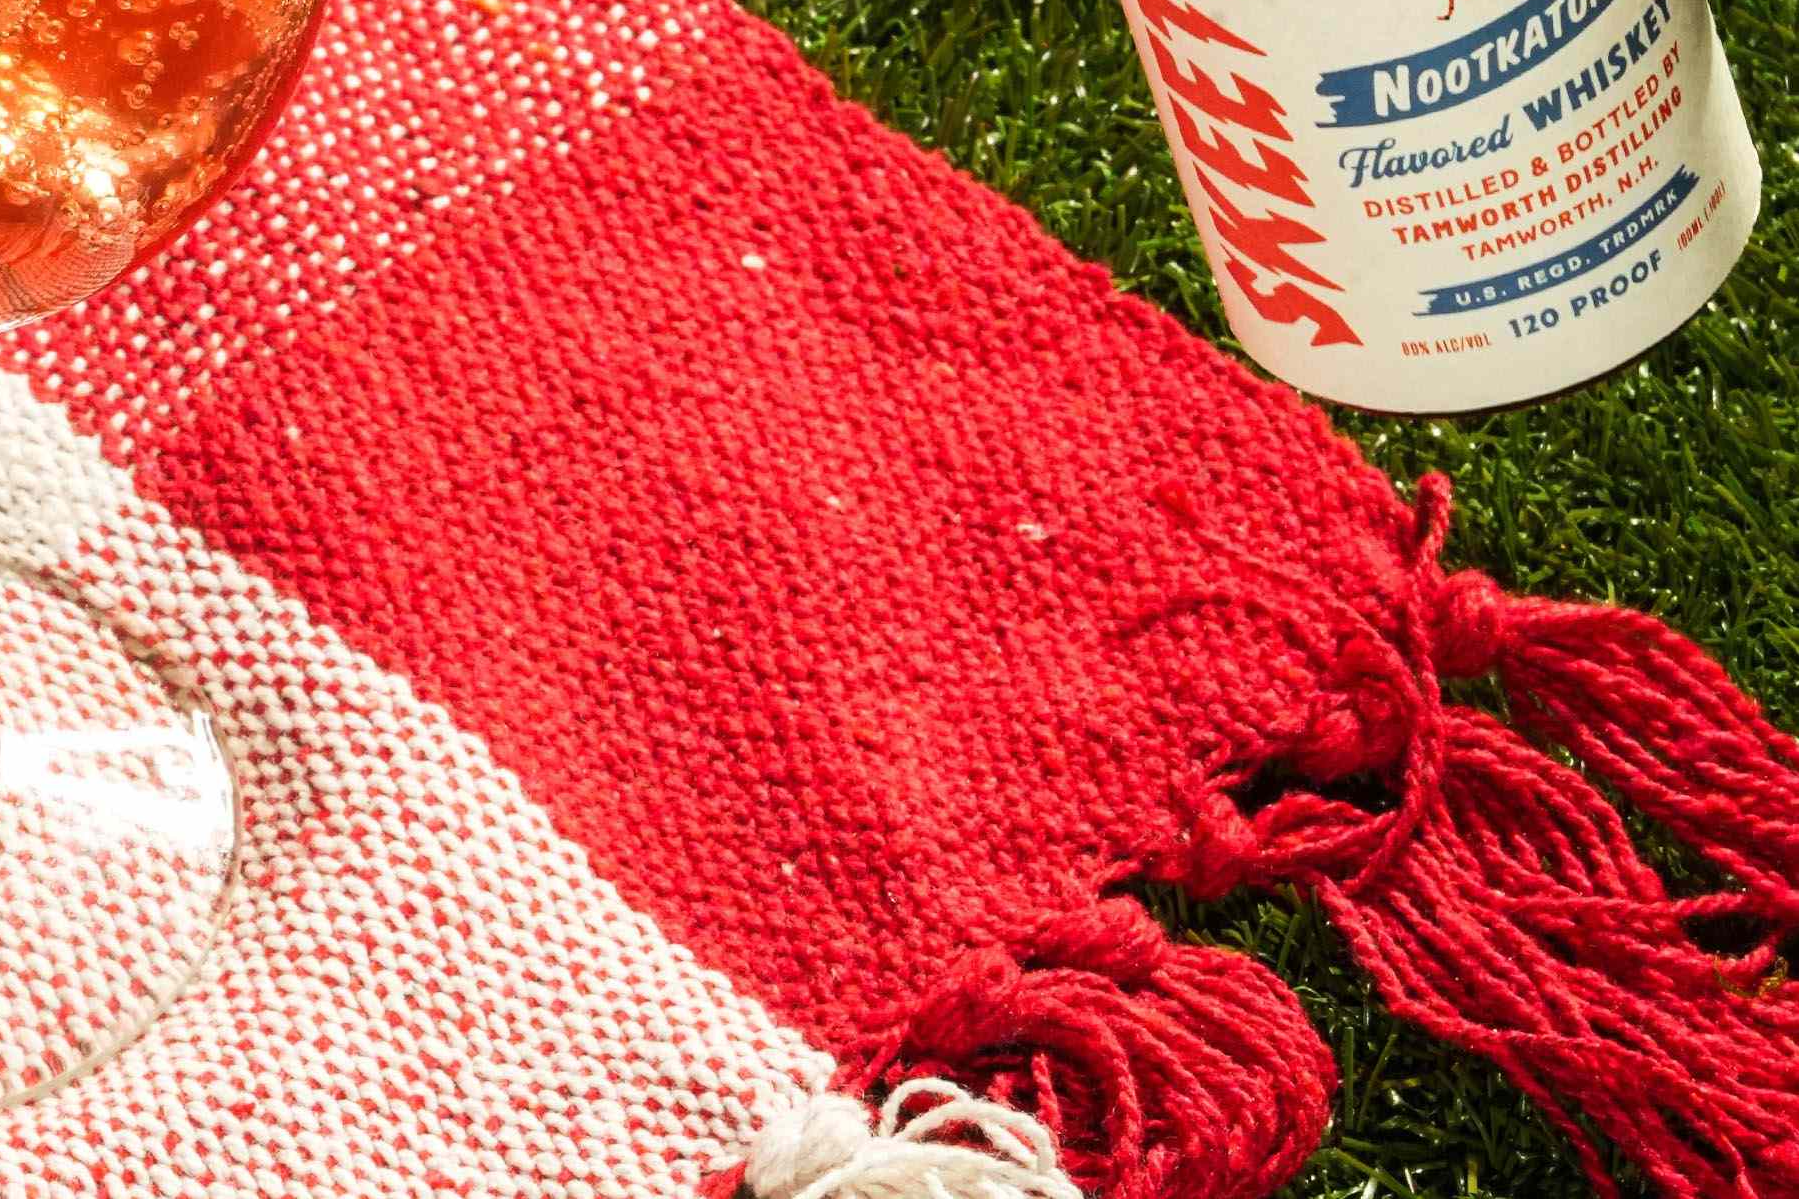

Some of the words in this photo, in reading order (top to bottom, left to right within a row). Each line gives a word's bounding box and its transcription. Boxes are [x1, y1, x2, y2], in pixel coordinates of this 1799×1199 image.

[1339, 113, 1514, 188] Flavored
[1363, 169, 1519, 218] DISTILLED
[1530, 156, 1549, 177] &
[1557, 73, 1659, 164] BOTTLED
[1662, 40, 1682, 78] BY
[1391, 185, 1558, 246] TAMWORTH
[1564, 85, 1682, 194] DISTILLING
[1617, 154, 1659, 195] N.H.
[1454, 285, 1508, 307] U.S.
[1517, 254, 1592, 292] REGD.
[1598, 189, 1678, 254] TRDMRK
[1507, 306, 1560, 339] 120
[1569, 248, 1663, 319] PROOF
